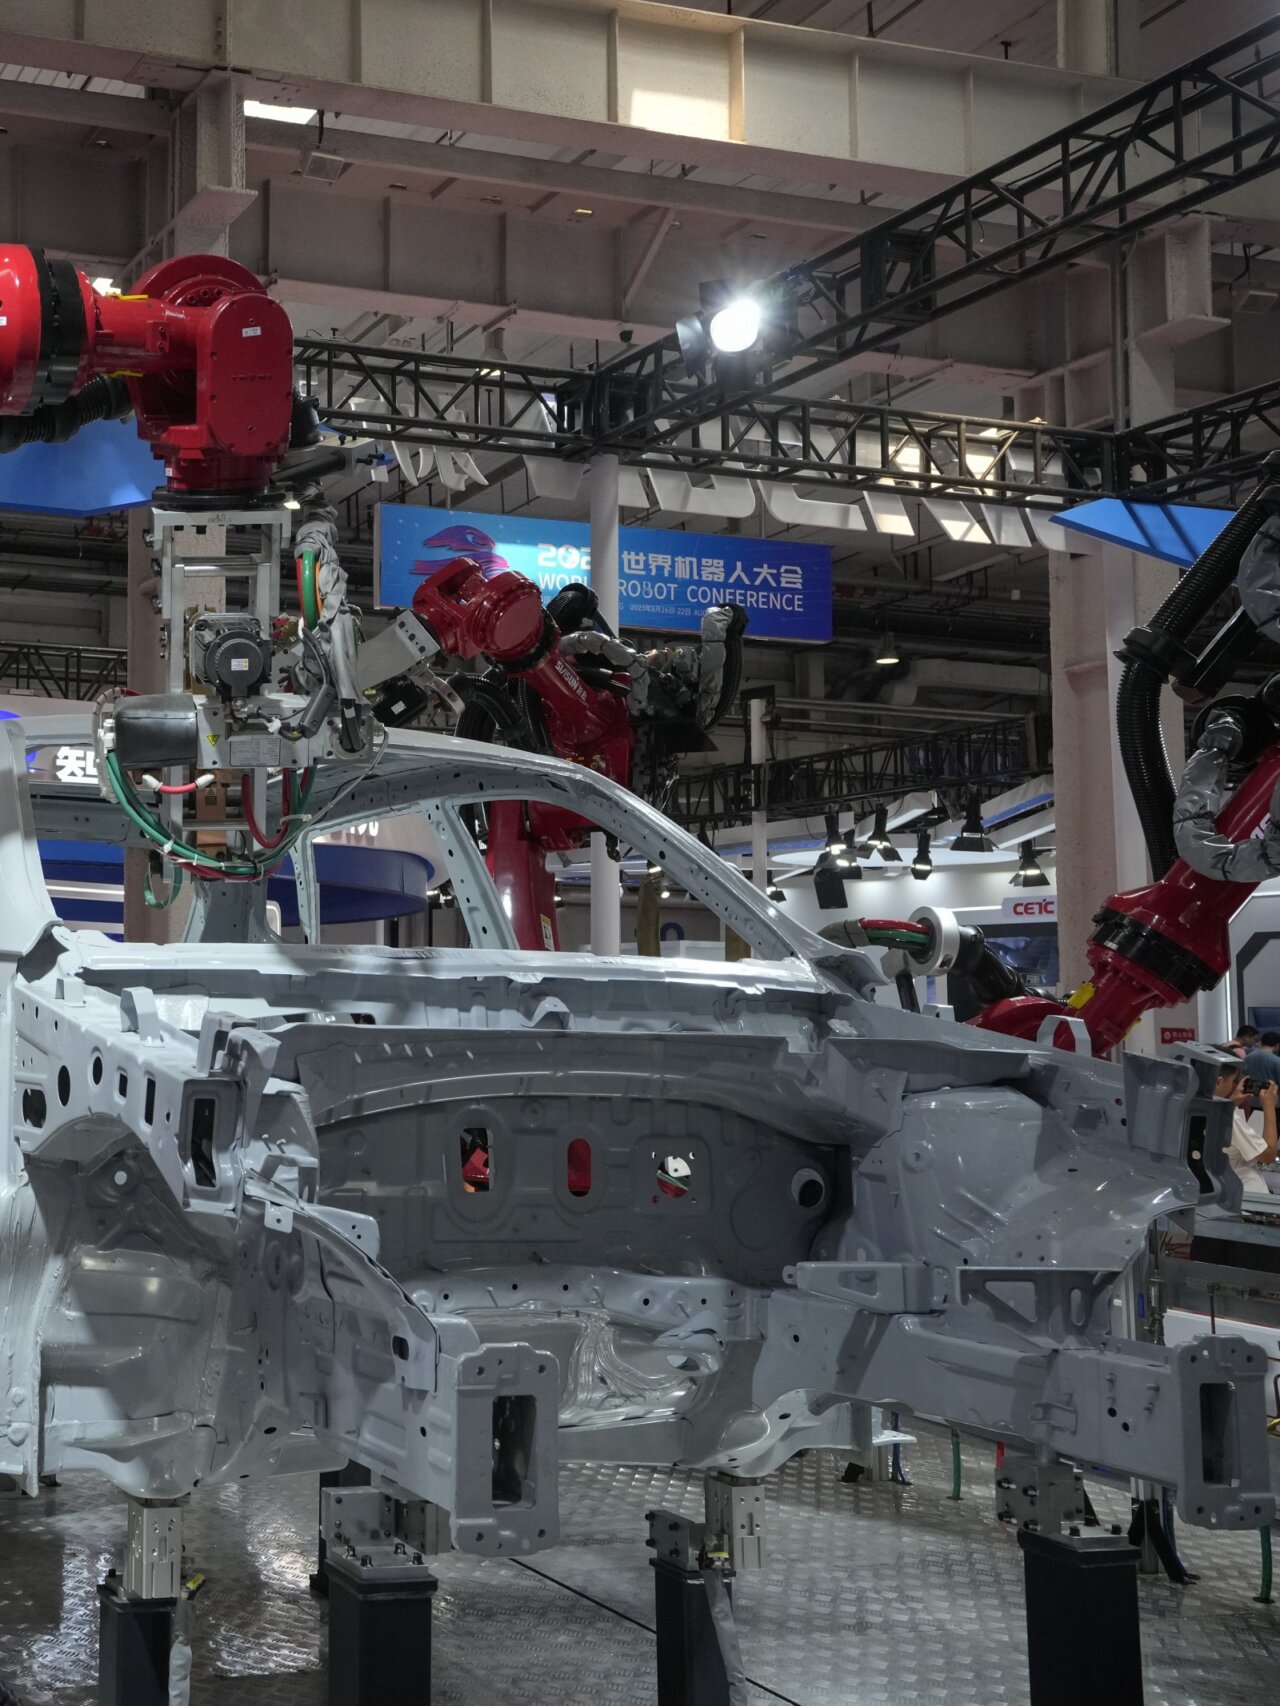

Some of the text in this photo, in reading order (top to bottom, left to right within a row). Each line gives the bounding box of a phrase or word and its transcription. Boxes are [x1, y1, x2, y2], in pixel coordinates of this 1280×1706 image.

[537, 543, 803, 589] 202 世界机器人大会
[618, 578, 678, 601] ROBOT
[687, 585, 804, 612] CONFERENCE
[554, 660, 579, 690] SIASUN
[1013, 899, 1055, 916] CETC
